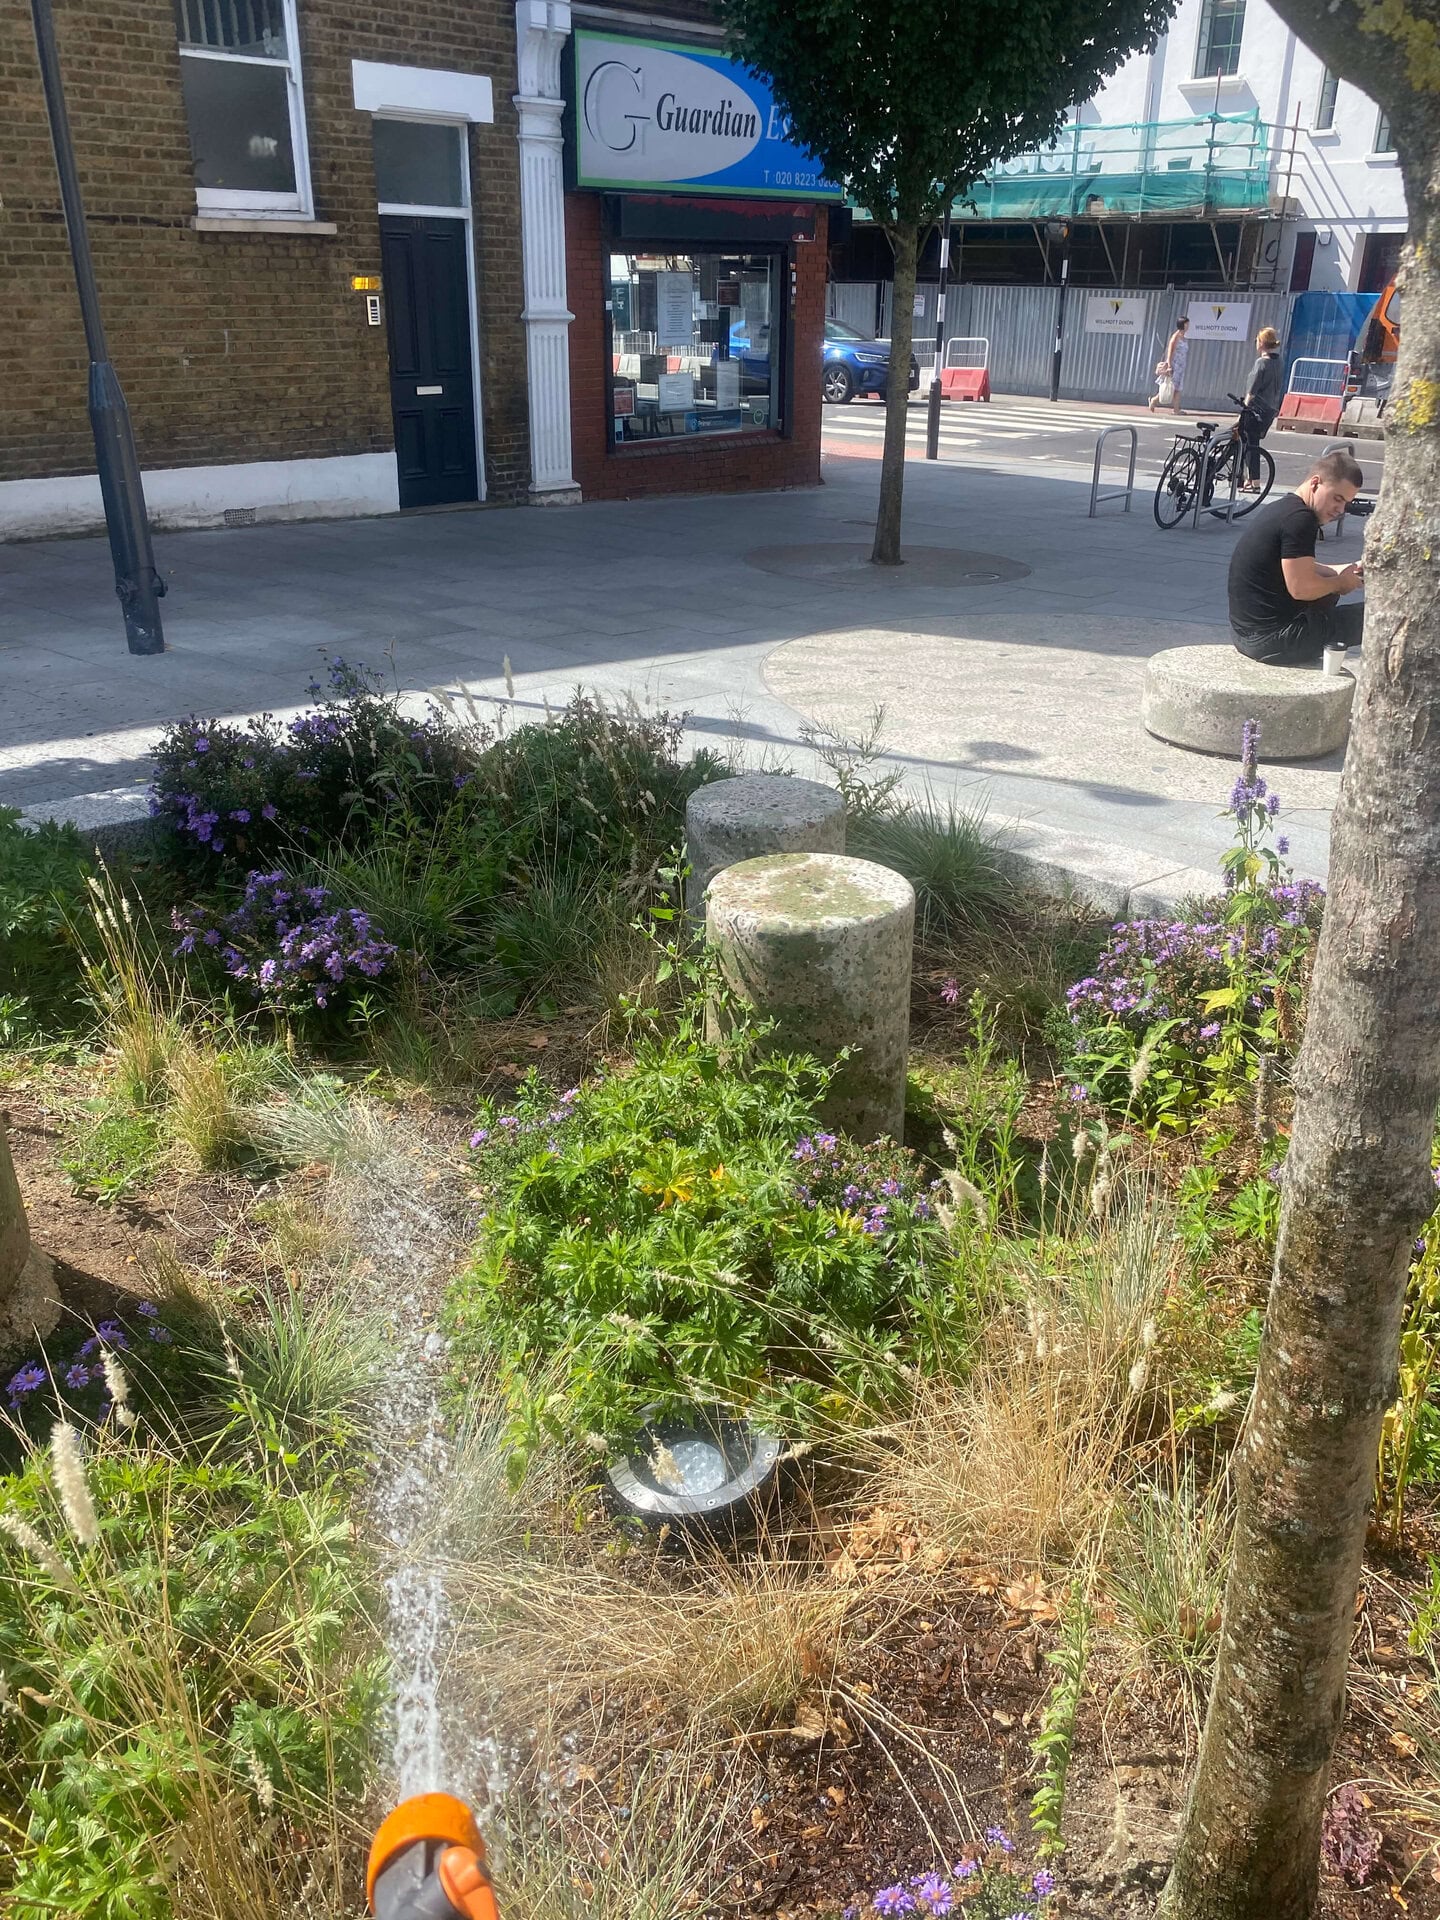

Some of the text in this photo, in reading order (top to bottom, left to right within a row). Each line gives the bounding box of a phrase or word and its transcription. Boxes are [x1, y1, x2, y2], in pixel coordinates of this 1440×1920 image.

[584, 60, 650, 151] G
[656, 93, 756, 138] Guardian
[775, 171, 792, 185] 020
[794, 171, 816, 187] 8223
[1094, 318, 1118, 326] WILLMOTT
